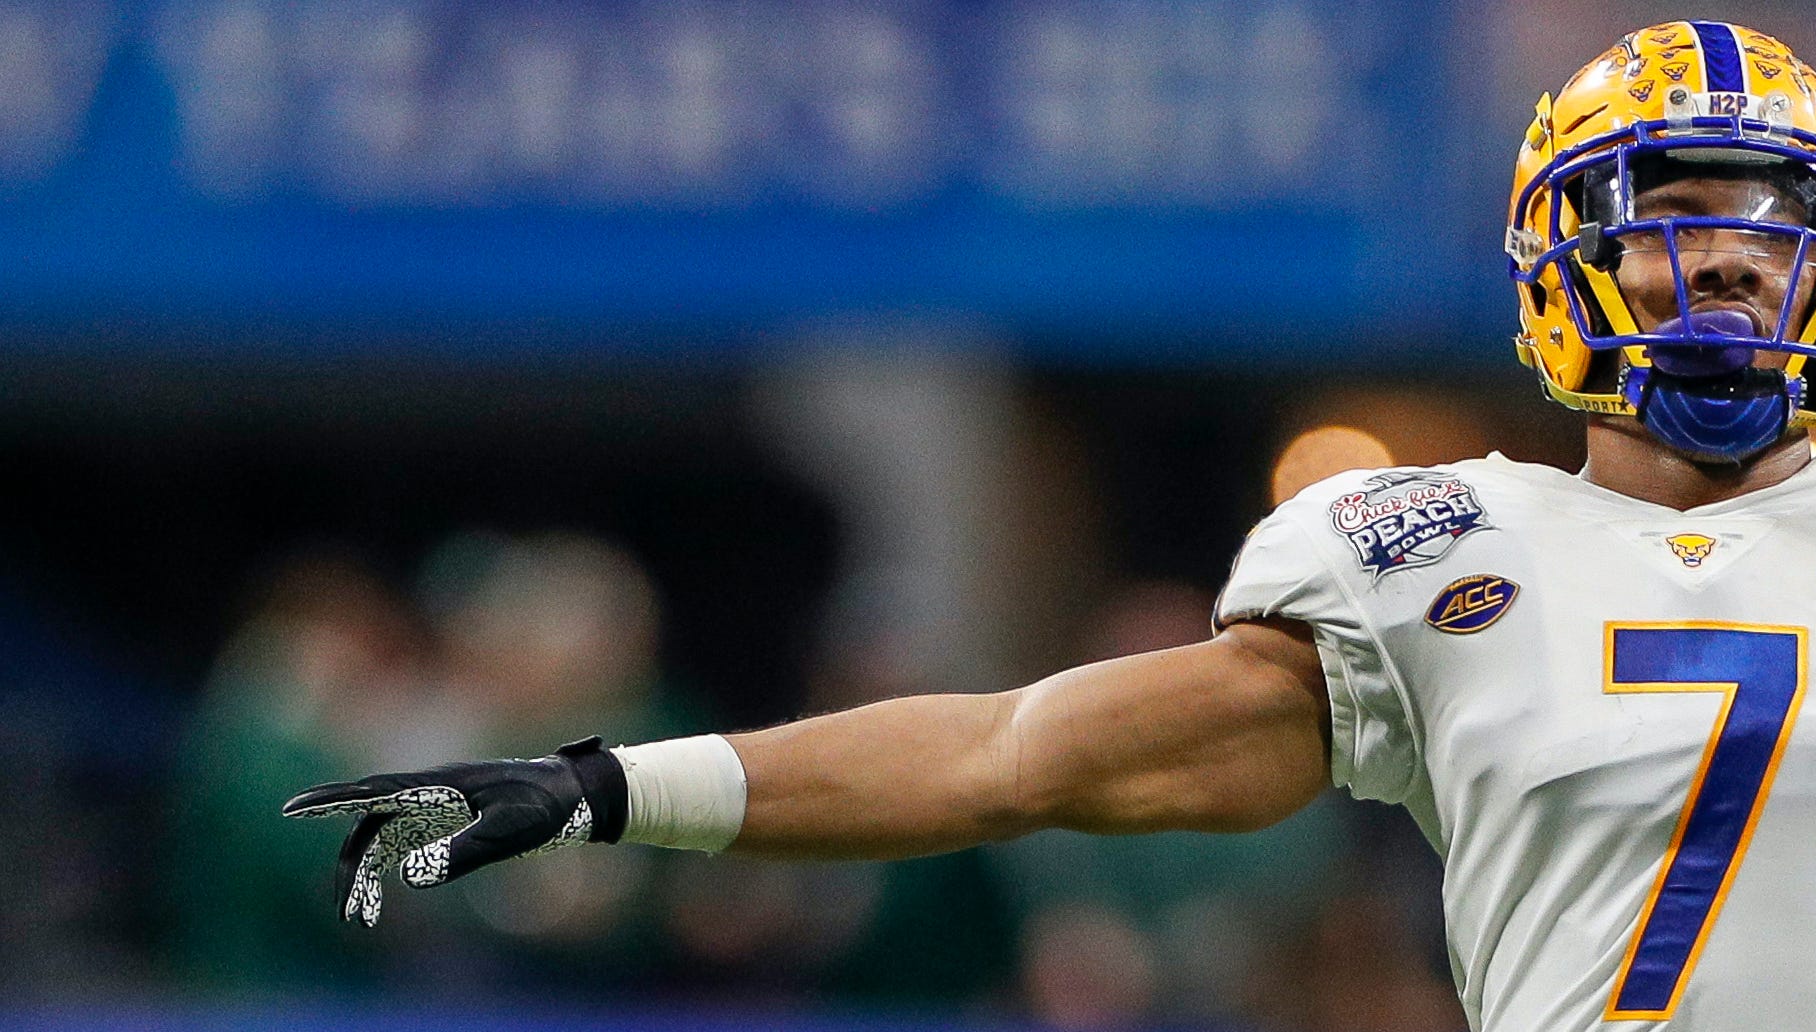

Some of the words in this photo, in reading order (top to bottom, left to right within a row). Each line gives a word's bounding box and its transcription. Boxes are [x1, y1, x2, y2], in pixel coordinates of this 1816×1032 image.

[1709, 94, 1748, 116] H2P
[1351, 494, 1480, 562] PEACH
[1387, 521, 1461, 558] BOWL
[1440, 579, 1504, 619] ACC
[1602, 619, 1810, 1022] 7
